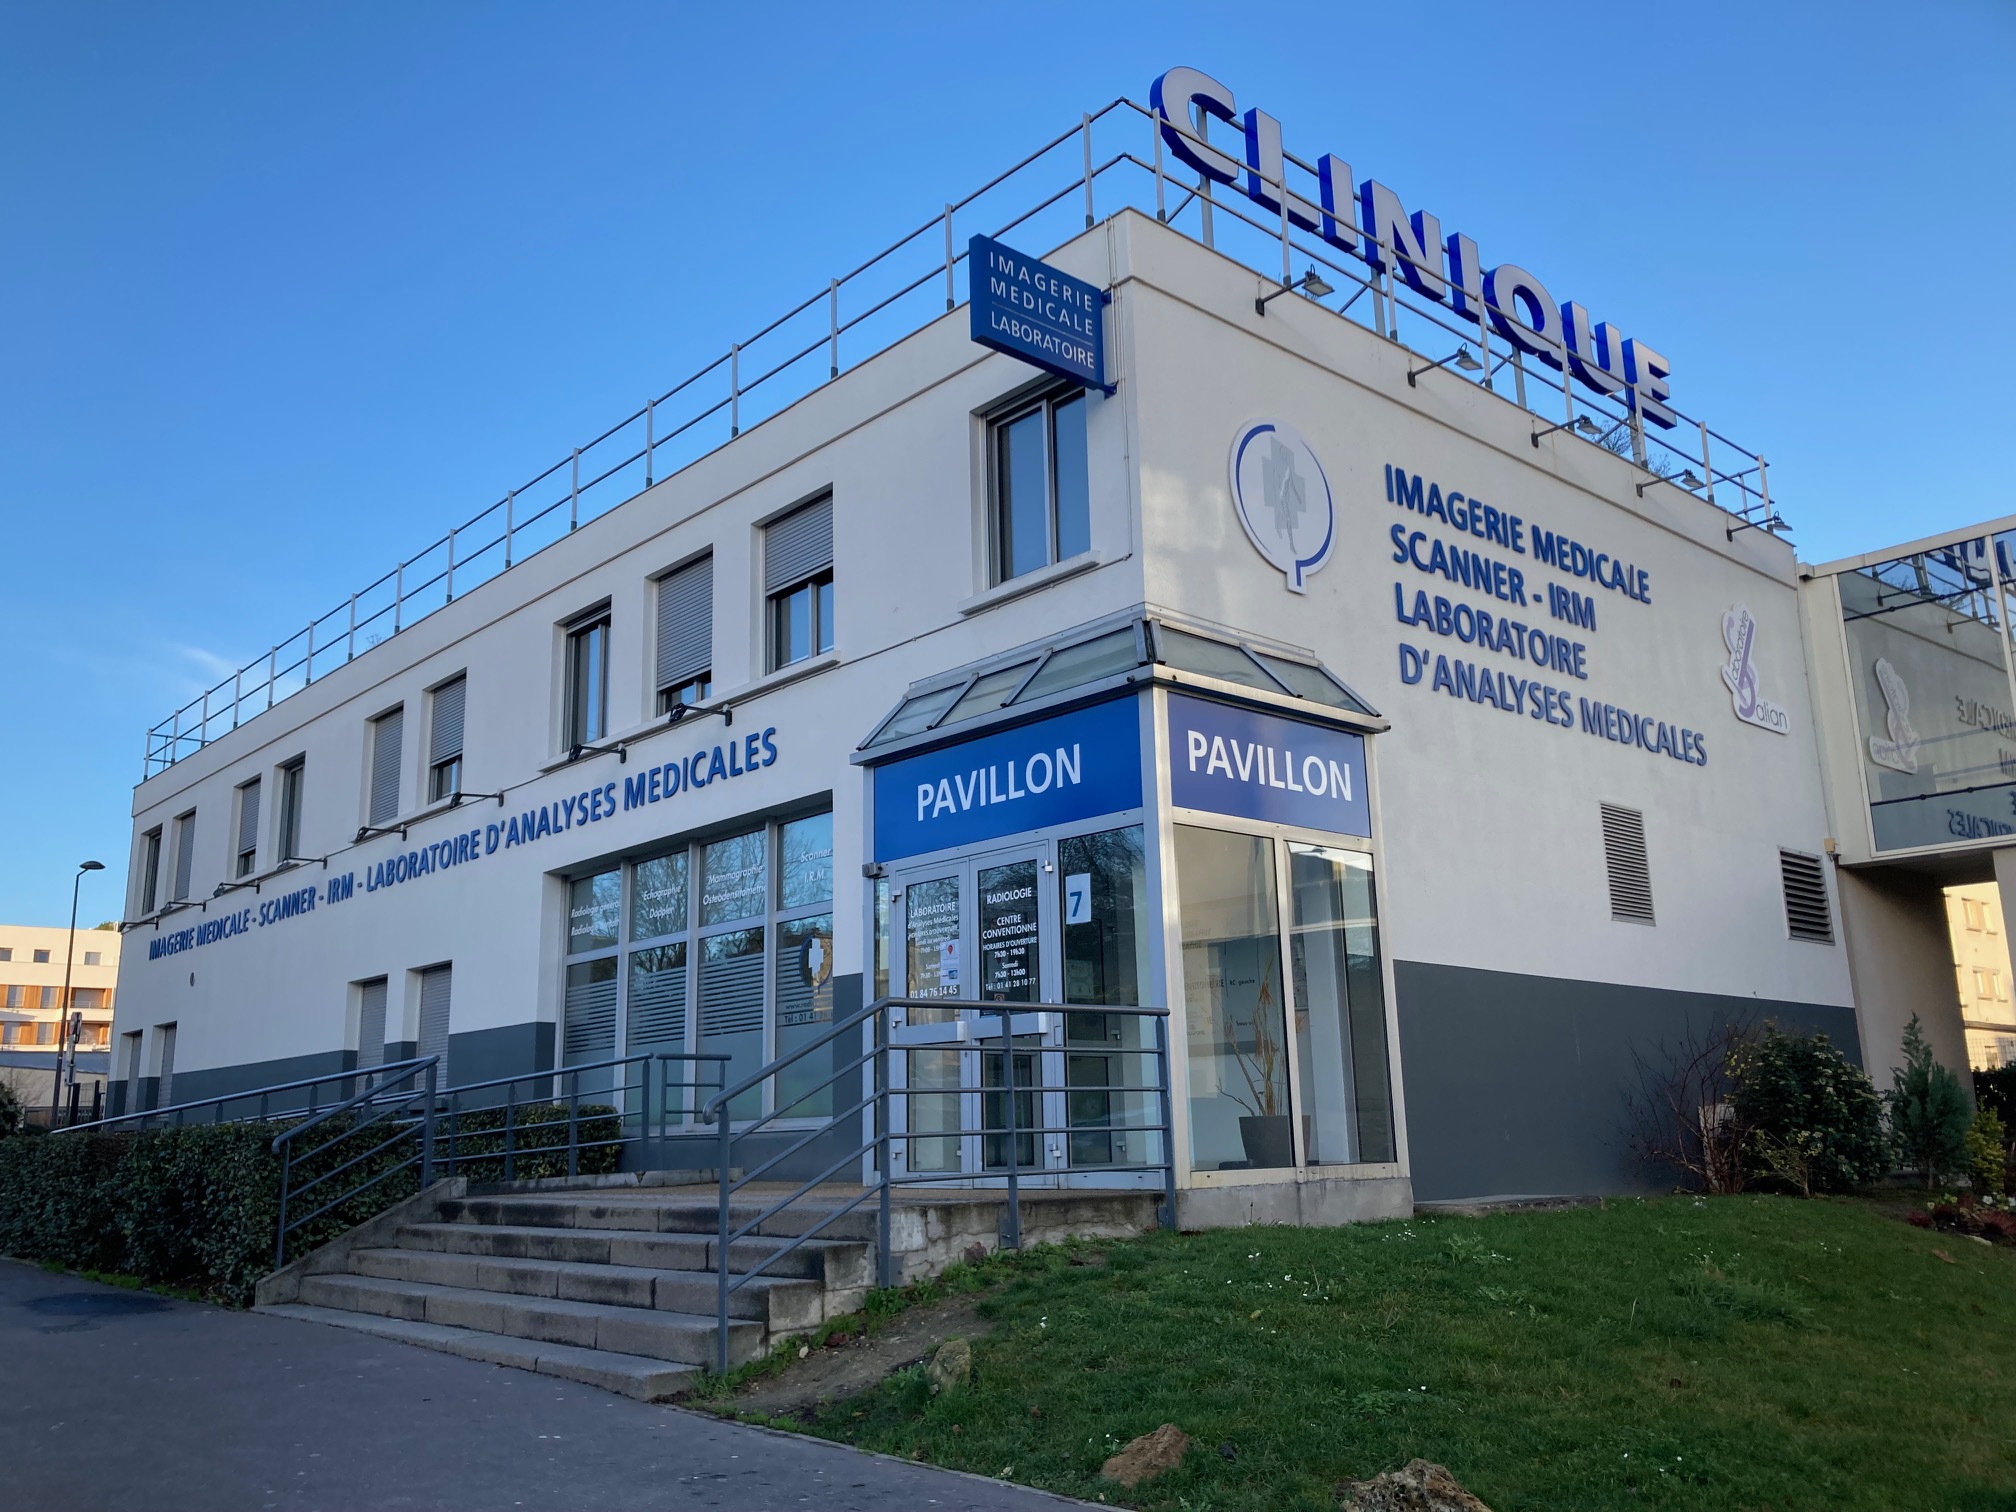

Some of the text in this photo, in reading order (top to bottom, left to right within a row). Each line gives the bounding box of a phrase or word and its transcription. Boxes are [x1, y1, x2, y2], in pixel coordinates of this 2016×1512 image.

[1150, 65, 1677, 430] CLINIQUE
[990, 251, 1093, 312] IMAGERIE
[990, 276, 1093, 336] MEDICALE
[991, 311, 1095, 369] LABORATOIRE
[1384, 463, 1652, 604] IMAGERIE MEDICALE
[1390, 523, 1528, 607] SCANNER
[1548, 582, 1597, 631] IRM
[1394, 582, 1589, 680] LABORATOIRE
[1399, 643, 1709, 767] D'ANALYSES MEDICALES
[917, 743, 1081, 822] PAVILLON
[1187, 730, 1352, 802] PAVILLON
[149, 927, 195, 961] IMAGERIE
[196, 908, 250, 947] MEDICALE
[258, 886, 316, 927] SCANNER
[326, 872, 354, 905] IRM
[366, 829, 481, 893] LABORATOIRE
[485, 782, 616, 854] D'ANALYSES
[623, 727, 778, 811] MEDICALES
[800, 848, 831, 863] Scanner
[708, 864, 763, 884] Mammographie
[986, 886, 1032, 904] RADIOLOGIE
[649, 906, 674, 919] Doppler
[996, 914, 1022, 926] CENTRE
[1070, 890, 1082, 918] 7
[982, 922, 1037, 939] CONVENTIONNE
[983, 937, 1038, 951] HORAIRES D'OUVERTURE
[996, 981, 1004, 990] 01
[1021, 978, 1028, 986] 10
[1028, 977, 1036, 985] 77
[1001, 960, 1019, 970] Samedi
[910, 985, 958, 999] 01 84 76 14 45
